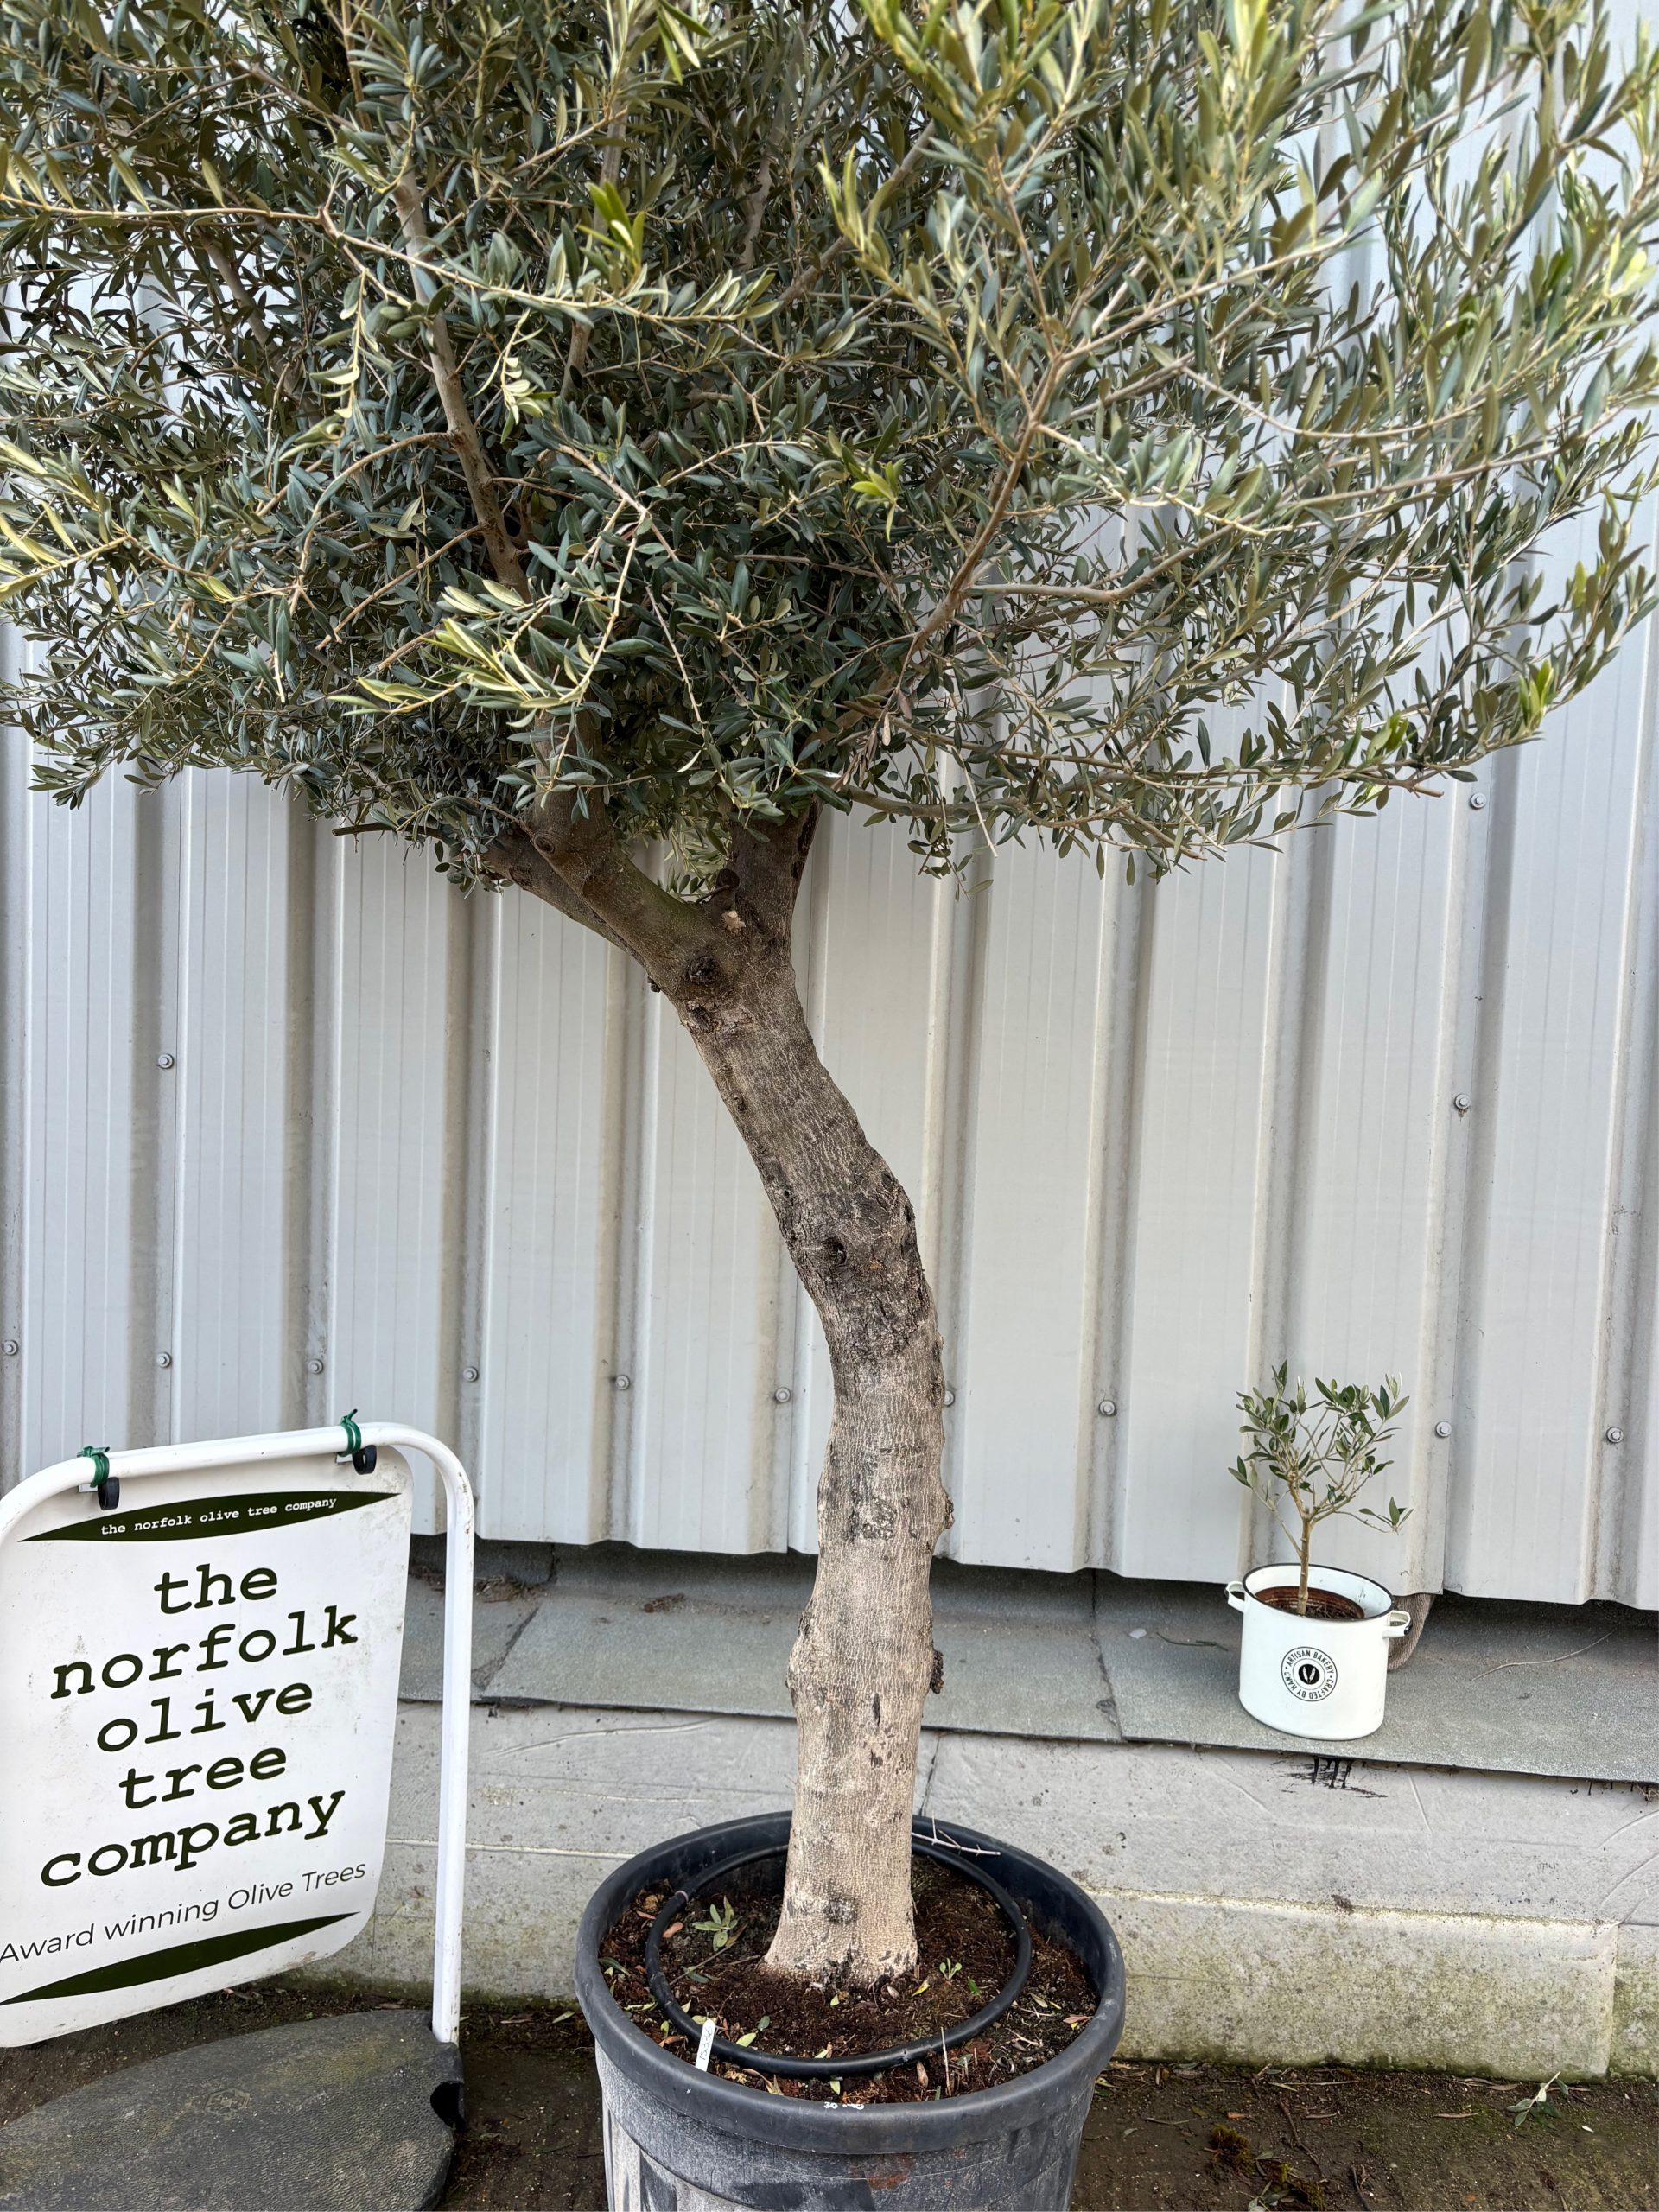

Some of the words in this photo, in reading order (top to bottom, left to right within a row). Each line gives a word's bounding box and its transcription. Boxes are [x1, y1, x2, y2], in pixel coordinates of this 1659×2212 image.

[100, 1524, 126, 1535] the
[134, 1514, 193, 1532] norfolk
[200, 1510, 240, 1522] olive
[247, 1505, 278, 1516] tree
[284, 1497, 338, 1512] company
[153, 1563, 278, 1615] the
[50, 1605, 359, 1700] norfolk
[1285, 1649, 1311, 1667] ARTISAN
[1313, 1651, 1335, 1674] BAKERY
[97, 1682, 313, 1752] olive
[1296, 1688, 1306, 1698] BY
[1308, 1677, 1334, 1700] CRAFTED
[118, 1747, 287, 1809] tree
[41, 1789, 346, 1887] company
[0, 1923, 94, 1963] Award
[105, 1899, 219, 1942] winning
[228, 1881, 294, 1910] Olive
[302, 1863, 366, 1892] Trees
